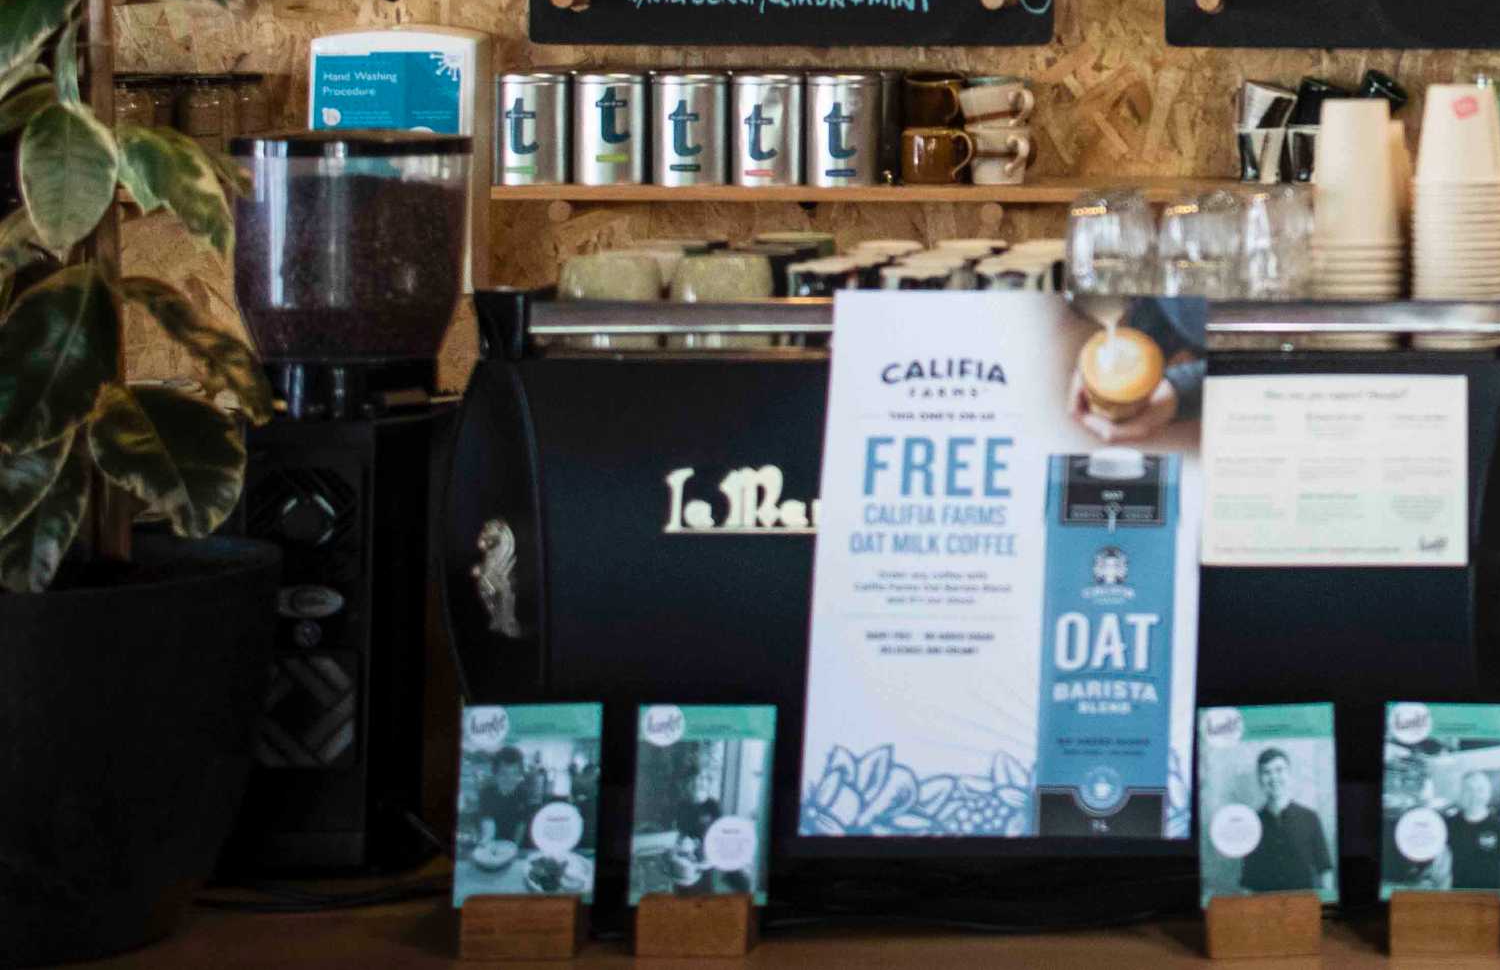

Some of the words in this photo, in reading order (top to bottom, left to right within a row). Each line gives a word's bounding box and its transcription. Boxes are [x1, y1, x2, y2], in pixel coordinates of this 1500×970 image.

[322, 71, 350, 82] Hand
[354, 71, 398, 83] Washing
[322, 86, 376, 97] Procedure
[880, 358, 1009, 385] CALIFIA
[862, 435, 1015, 499] FREE
[863, 503, 936, 526] CALIFIA
[941, 503, 1008, 527] FARMS
[849, 531, 888, 555] OAT
[892, 532, 940, 556] MILK
[945, 532, 1018, 557] COFFEE
[1053, 610, 1161, 672] OAT
[1052, 680, 1159, 702] BARISTA
